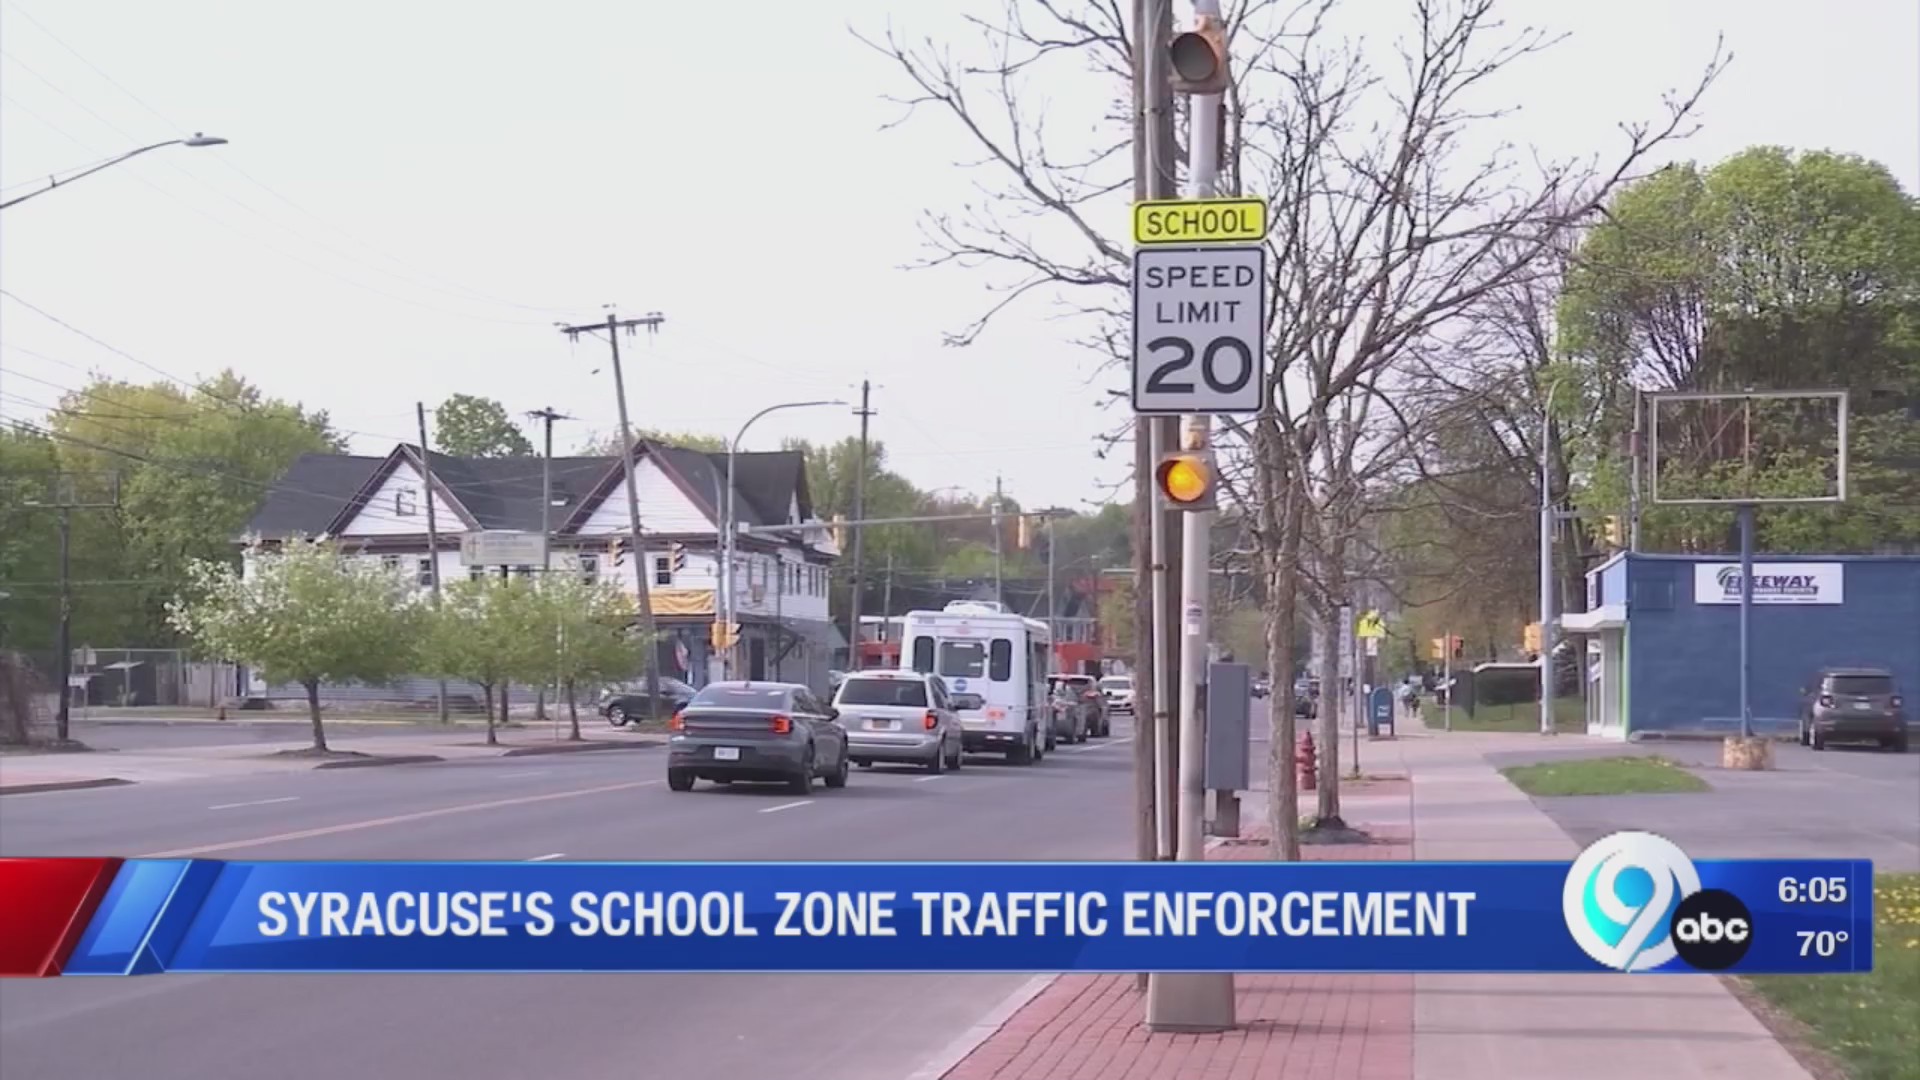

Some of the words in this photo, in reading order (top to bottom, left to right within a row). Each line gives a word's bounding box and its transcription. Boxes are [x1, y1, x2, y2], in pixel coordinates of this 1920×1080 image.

[1147, 209, 1256, 236] SCHOOL
[1145, 265, 1254, 289] SPEED
[1156, 301, 1241, 324] LIMIT
[1145, 335, 1253, 394] 20
